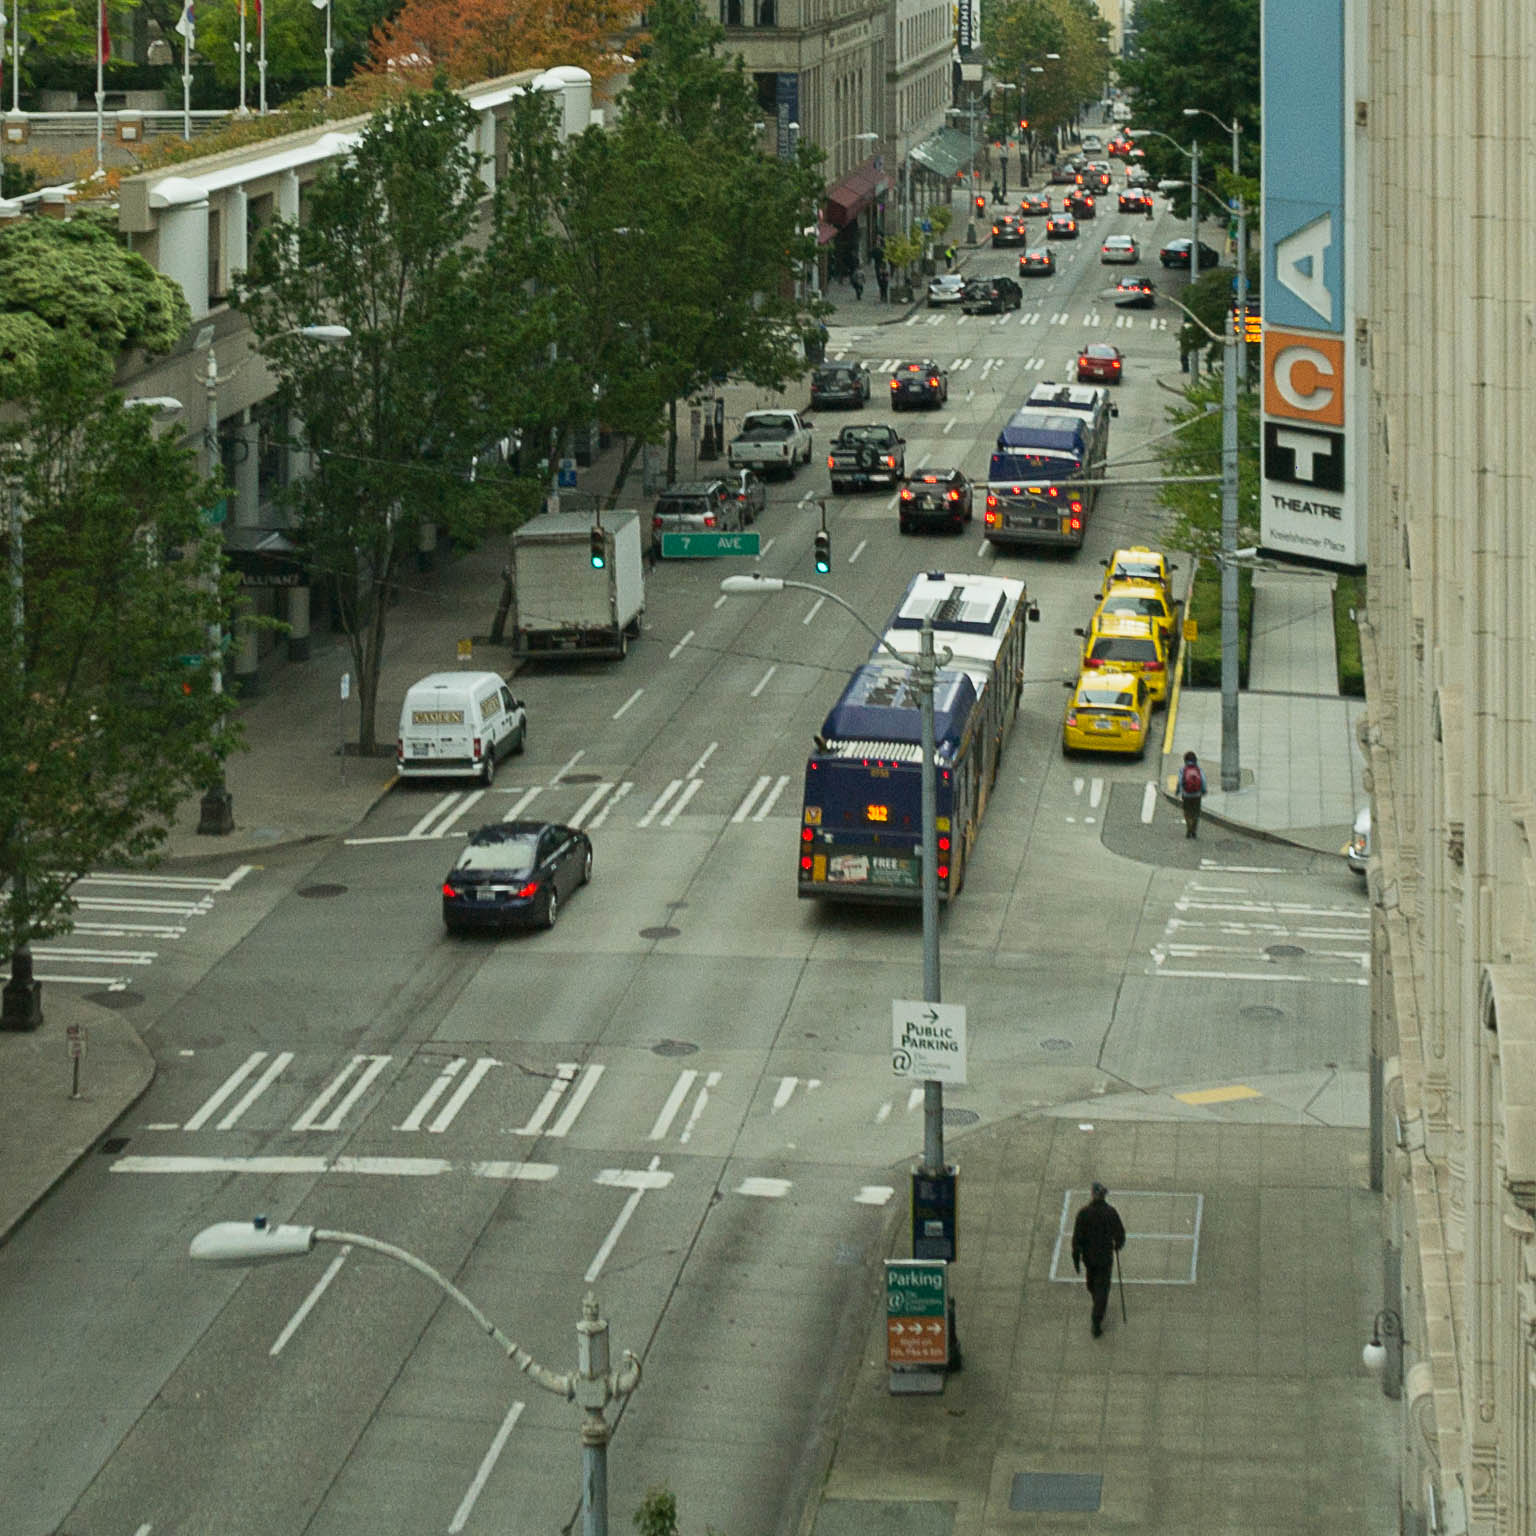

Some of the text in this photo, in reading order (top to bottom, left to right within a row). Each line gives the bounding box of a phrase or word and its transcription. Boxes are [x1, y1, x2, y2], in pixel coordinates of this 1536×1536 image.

[1271, 495, 1342, 520] THEATRE
[680, 537, 742, 550] 7 AVE
[867, 804, 889, 822] 312
[906, 1022, 953, 1039] PUBLIC
[901, 1034, 959, 1052] PARKING
[888, 1271, 943, 1290] Parking
